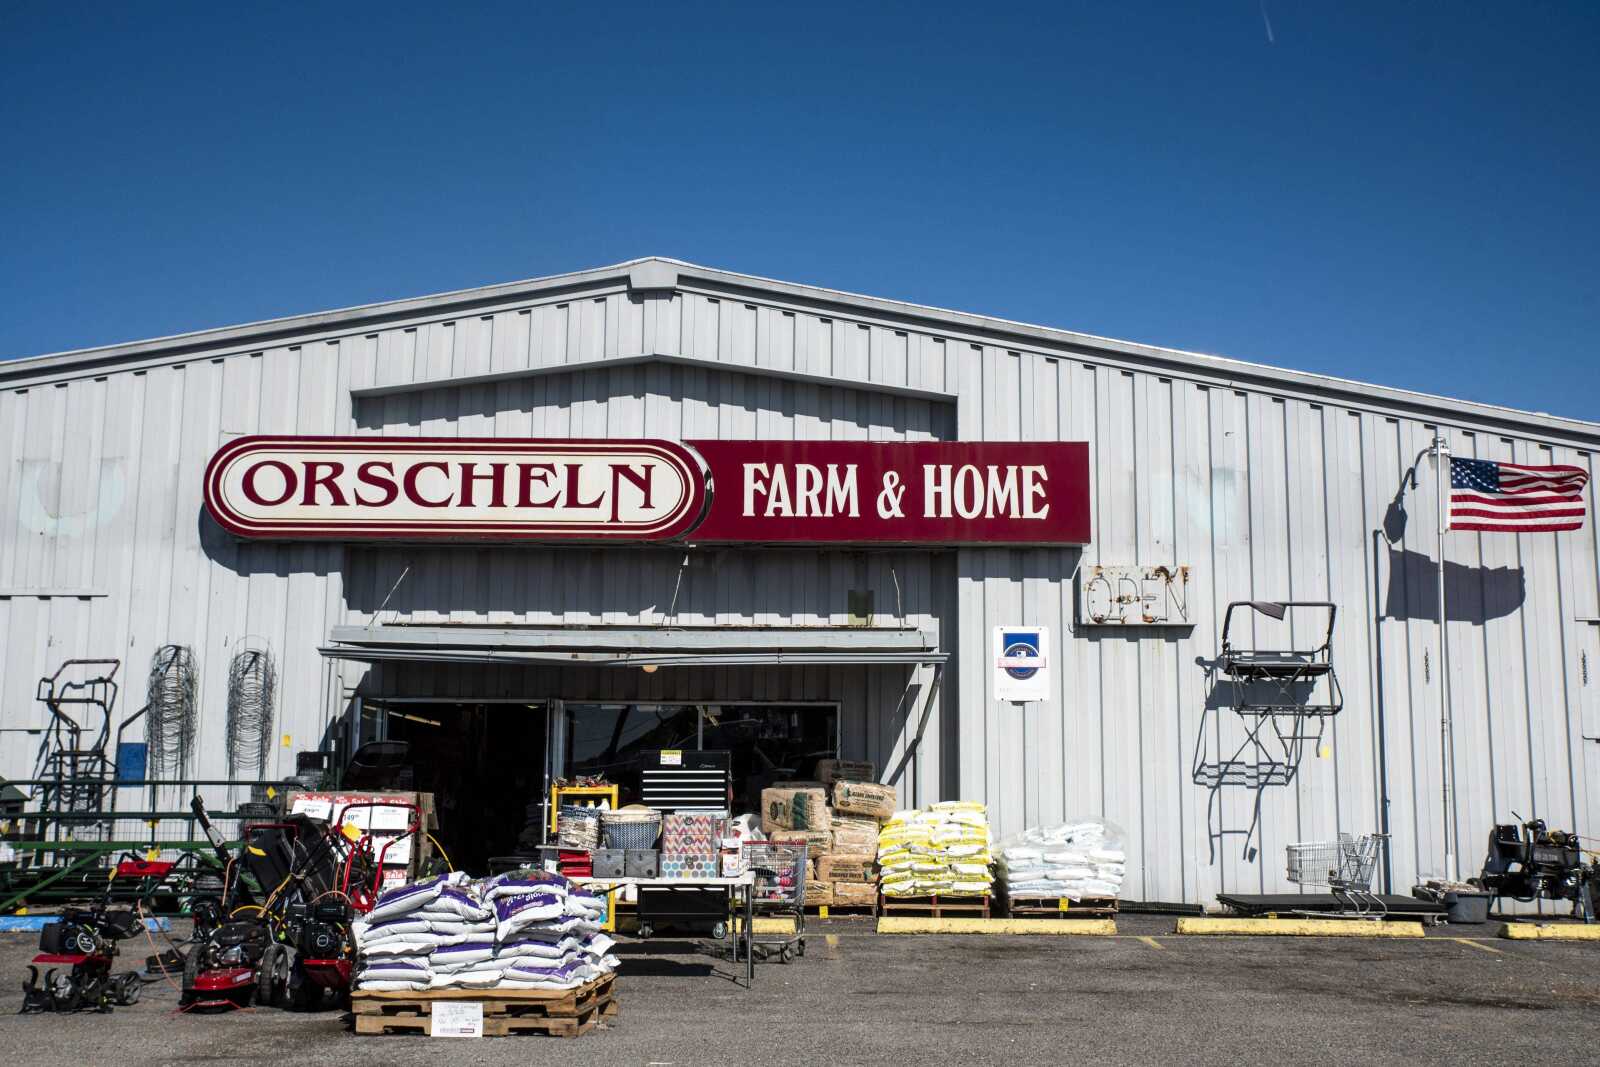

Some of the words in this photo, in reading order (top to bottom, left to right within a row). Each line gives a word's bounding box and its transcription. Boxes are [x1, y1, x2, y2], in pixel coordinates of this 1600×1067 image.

[241, 460, 657, 523] ORSCHELN
[742, 462, 861, 518] FARM
[876, 470, 906, 520] &
[923, 464, 1050, 520] HOME
[1086, 577, 1187, 622] OPEN
